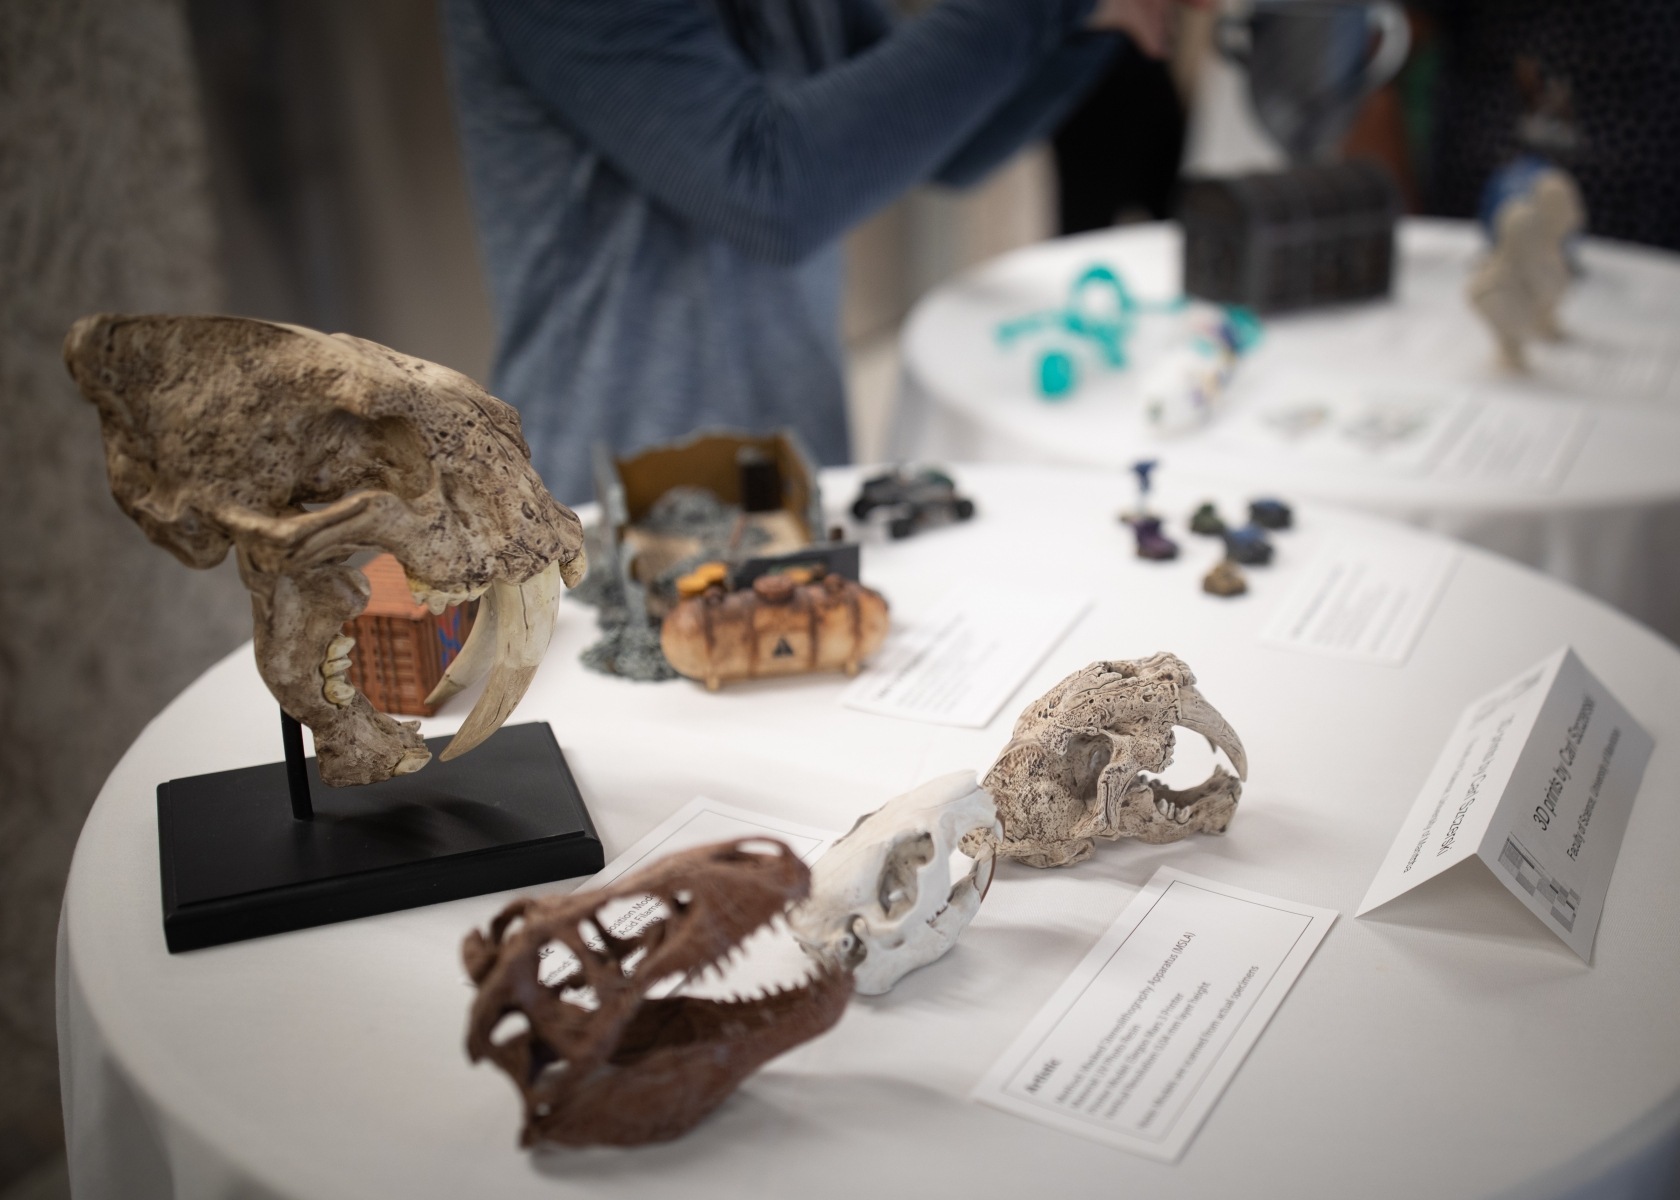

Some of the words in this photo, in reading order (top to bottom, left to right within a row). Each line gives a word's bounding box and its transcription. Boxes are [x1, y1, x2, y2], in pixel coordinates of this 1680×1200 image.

[1557, 735, 1578, 769] Carl
[1462, 771, 1489, 801] Carl
[1551, 757, 1572, 787] by
[1539, 771, 1566, 817] prints
[1434, 795, 1478, 858] Szczerski
[1531, 803, 1551, 833] 3D
[1565, 829, 1584, 863] Faculty
[618, 917, 638, 937] Acid
[1098, 985, 1156, 1047] Stereolithography
[1144, 952, 1180, 987] Apparatus
[1169, 930, 1197, 955] (MSLA)
[1159, 991, 1185, 1016] Printer
[1175, 1002, 1197, 1022] layer
[1187, 980, 1215, 1005] height
[1199, 1019, 1222, 1039] from
[1212, 998, 1237, 1021] actual
[1226, 964, 1262, 1001] specimens
[1022, 1057, 1062, 1095] Artistic
